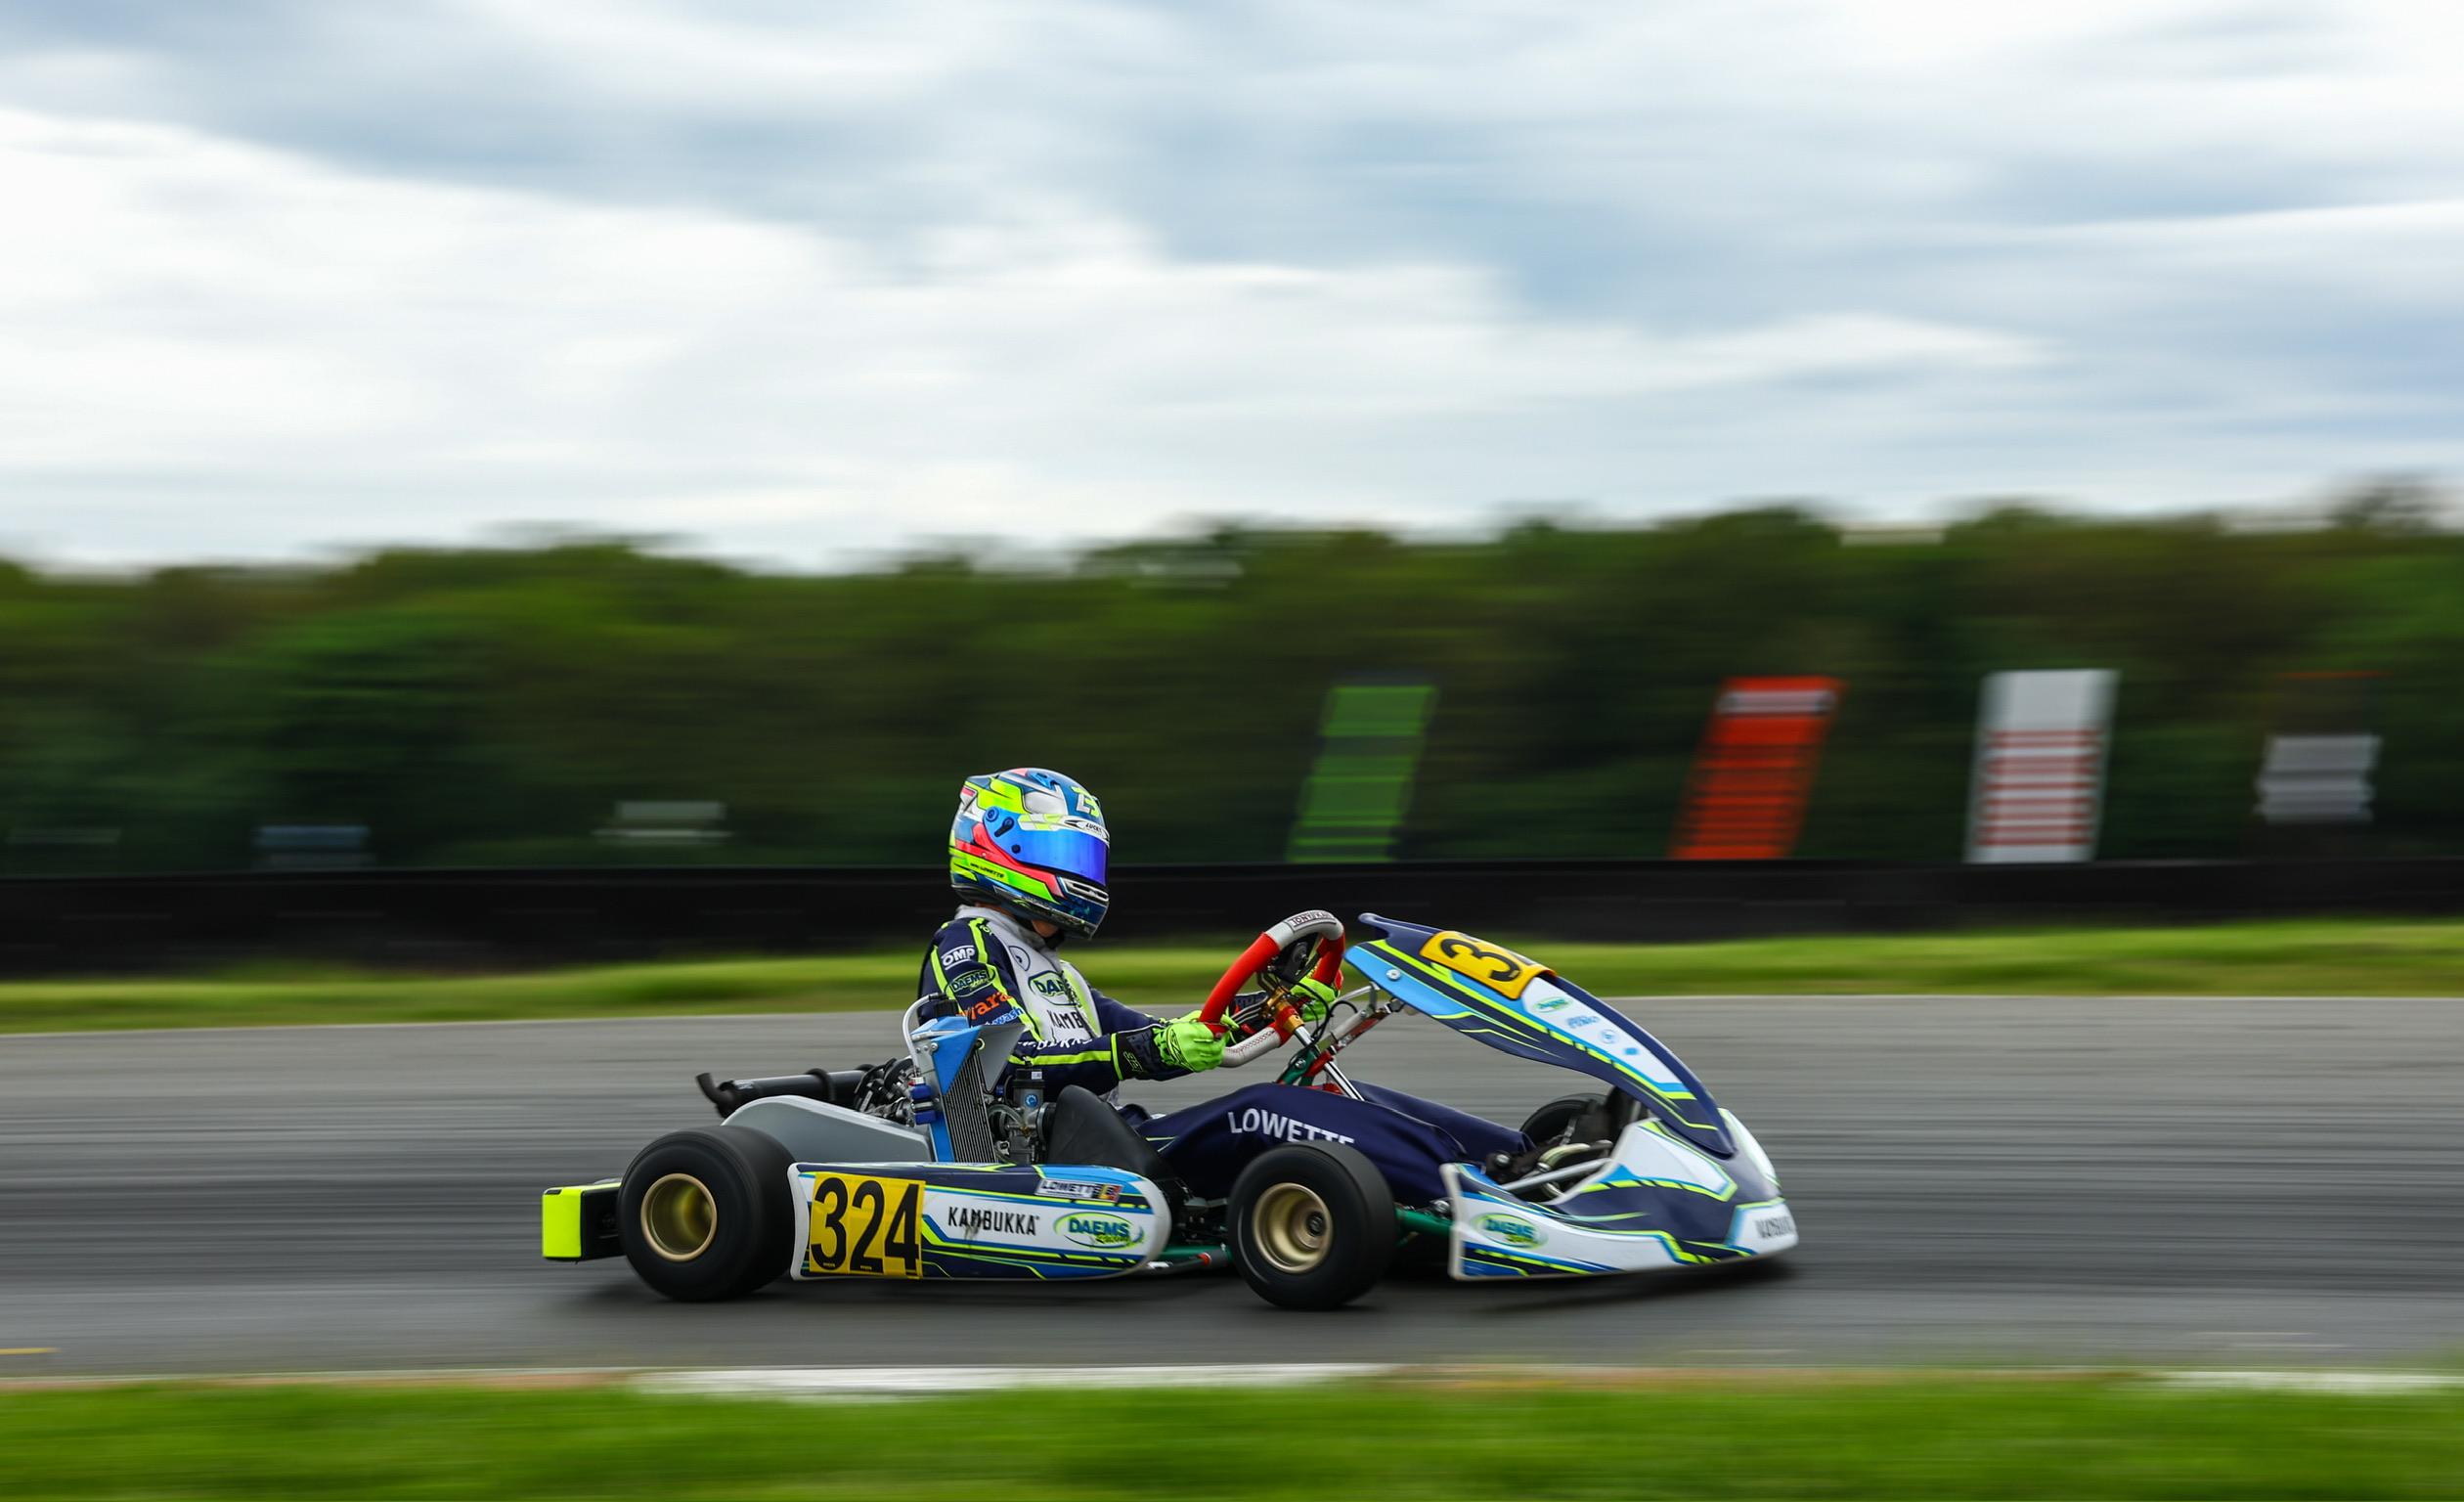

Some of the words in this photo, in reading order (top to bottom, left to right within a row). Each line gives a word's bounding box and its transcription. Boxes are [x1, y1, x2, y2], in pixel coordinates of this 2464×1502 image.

[943, 948, 976, 966] OMP
[951, 970, 989, 992] DAEMS
[1042, 1179, 1102, 1199] LOWETTE
[811, 1177, 920, 1275] 324
[948, 1207, 1036, 1236] KAMBUKKA
[1069, 1216, 1129, 1237] DAEMS
